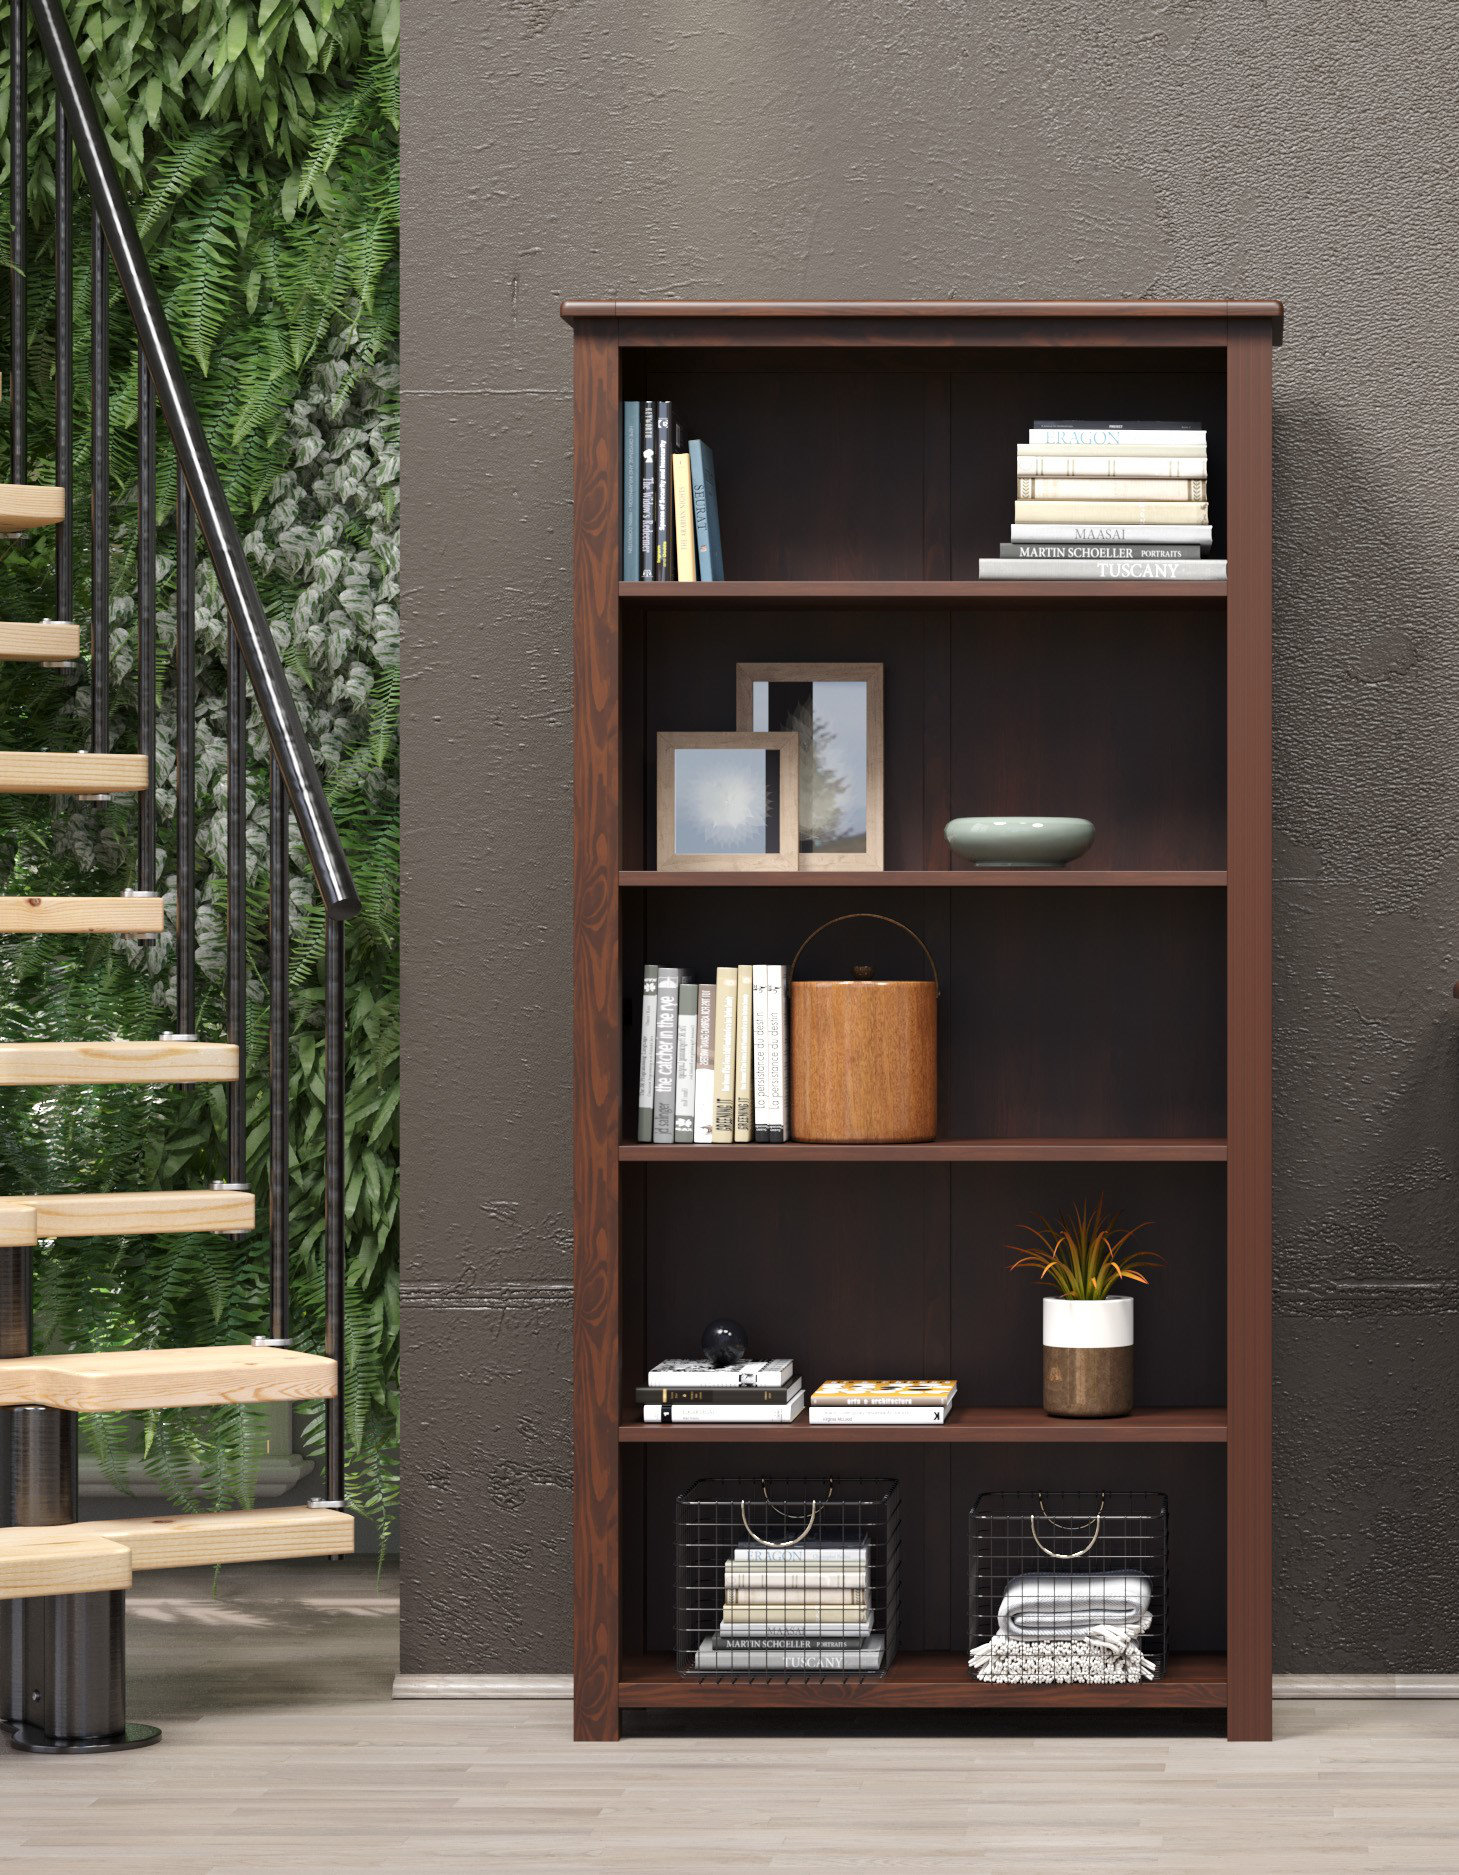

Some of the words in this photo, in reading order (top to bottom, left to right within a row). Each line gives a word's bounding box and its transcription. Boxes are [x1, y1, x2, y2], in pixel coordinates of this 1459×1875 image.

[1045, 430, 1120, 445] ERAGON
[659, 440, 667, 468] Insecurity
[658, 468, 666, 480] and
[642, 477, 654, 490] The
[659, 480, 667, 503] Security
[642, 492, 654, 519] Widow's
[659, 503, 666, 511] of
[694, 484, 708, 530] SEURAT
[658, 510, 667, 531] Spaces
[642, 520, 654, 553] Redeemer
[1074, 528, 1126, 541] MAASAI
[1019, 546, 1066, 559] MARTIN
[1067, 547, 1133, 559] SCHOELLER
[1140, 549, 1182, 558] PORTRAITS
[1096, 561, 1180, 579] TUSCANY
[660, 996, 678, 1011] rye
[658, 1013, 675, 1028] the
[754, 1012, 765, 1036] destin
[768, 1012, 778, 1036] destin
[656, 1031, 674, 1039] in
[754, 1038, 765, 1049] du
[768, 1038, 779, 1049] du
[656, 1041, 675, 1075] catcher
[755, 1051, 769, 1097] persistance
[769, 1051, 783, 1098] persistance
[656, 1077, 673, 1092] the
[755, 1099, 766, 1109] La
[769, 1100, 780, 1110] La
[655, 1102, 671, 1127] salinger
[716, 1104, 733, 1132] GREENING
[737, 1103, 750, 1131] GREENING
[871, 1397, 913, 1405] architecture
[747, 1550, 803, 1562] ERAGON
[766, 1628, 805, 1636] MAASA
[726, 1639, 761, 1648] MARTIN
[782, 1657, 844, 1668] TUSCANY
